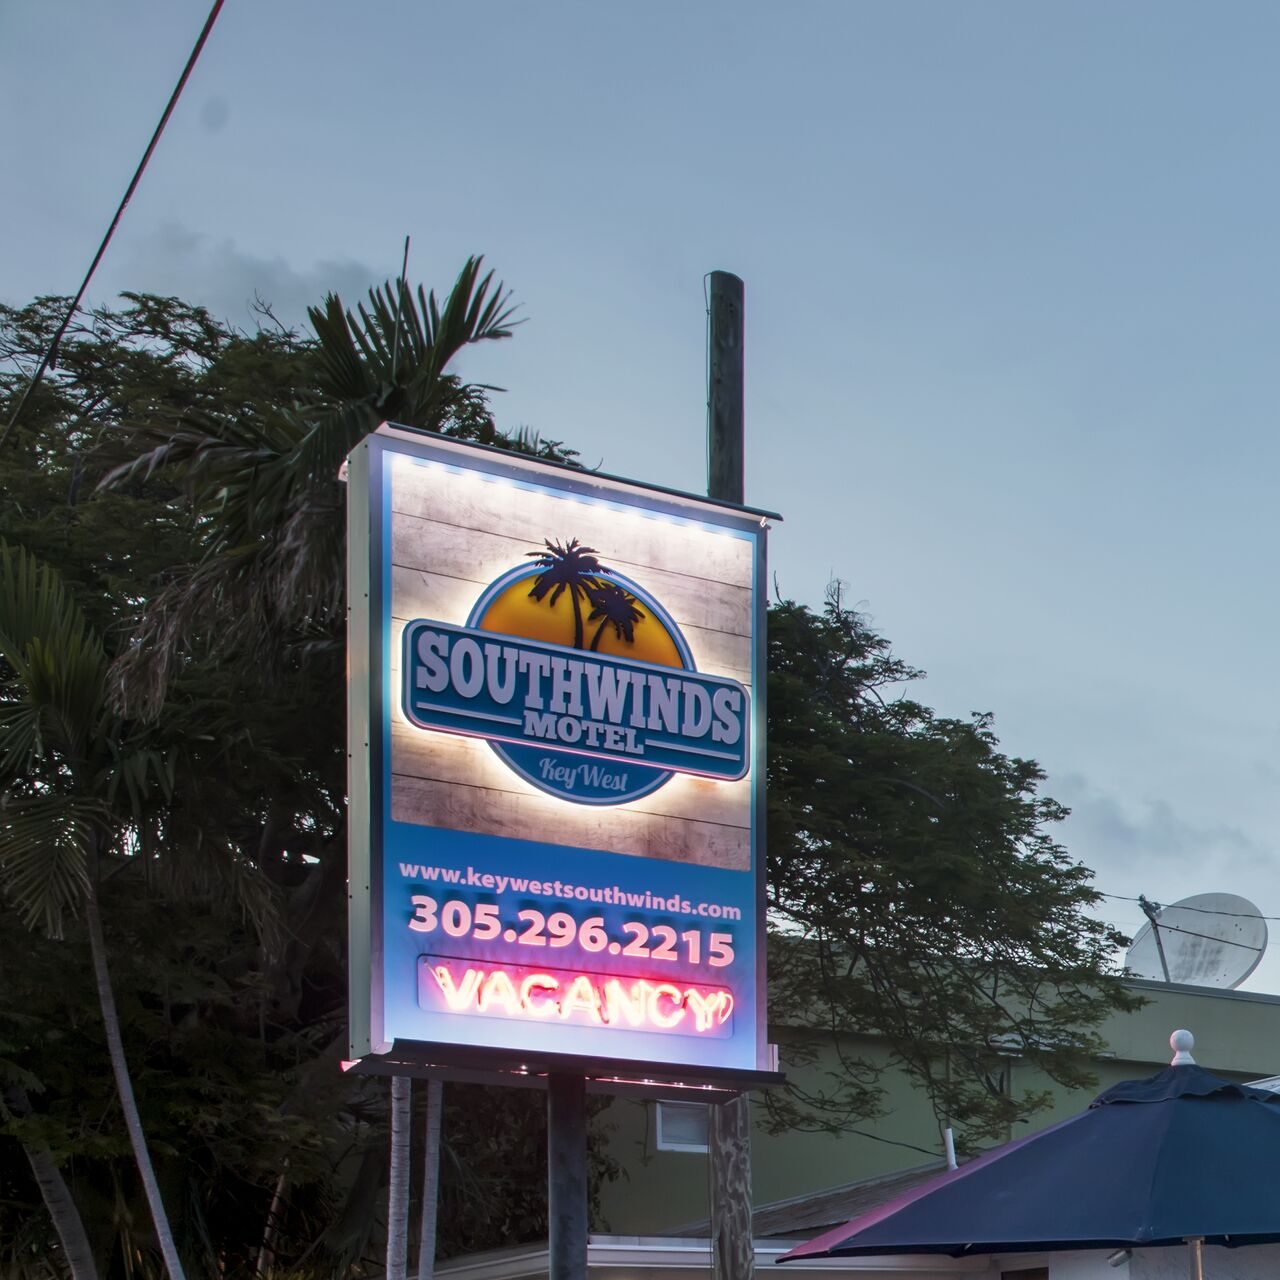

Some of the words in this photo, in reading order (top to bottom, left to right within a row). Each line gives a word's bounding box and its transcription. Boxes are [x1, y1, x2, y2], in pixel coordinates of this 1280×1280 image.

[416, 630, 741, 745] SOUTHWINDS
[523, 710, 645, 755] MOTEL
[539, 758, 580, 787] Key
[578, 764, 629, 792] West
[399, 862, 742, 921] www.keywestsouthwinds.com
[408, 895, 735, 967] 305.296.2215
[432, 965, 733, 1033] VACANCY
